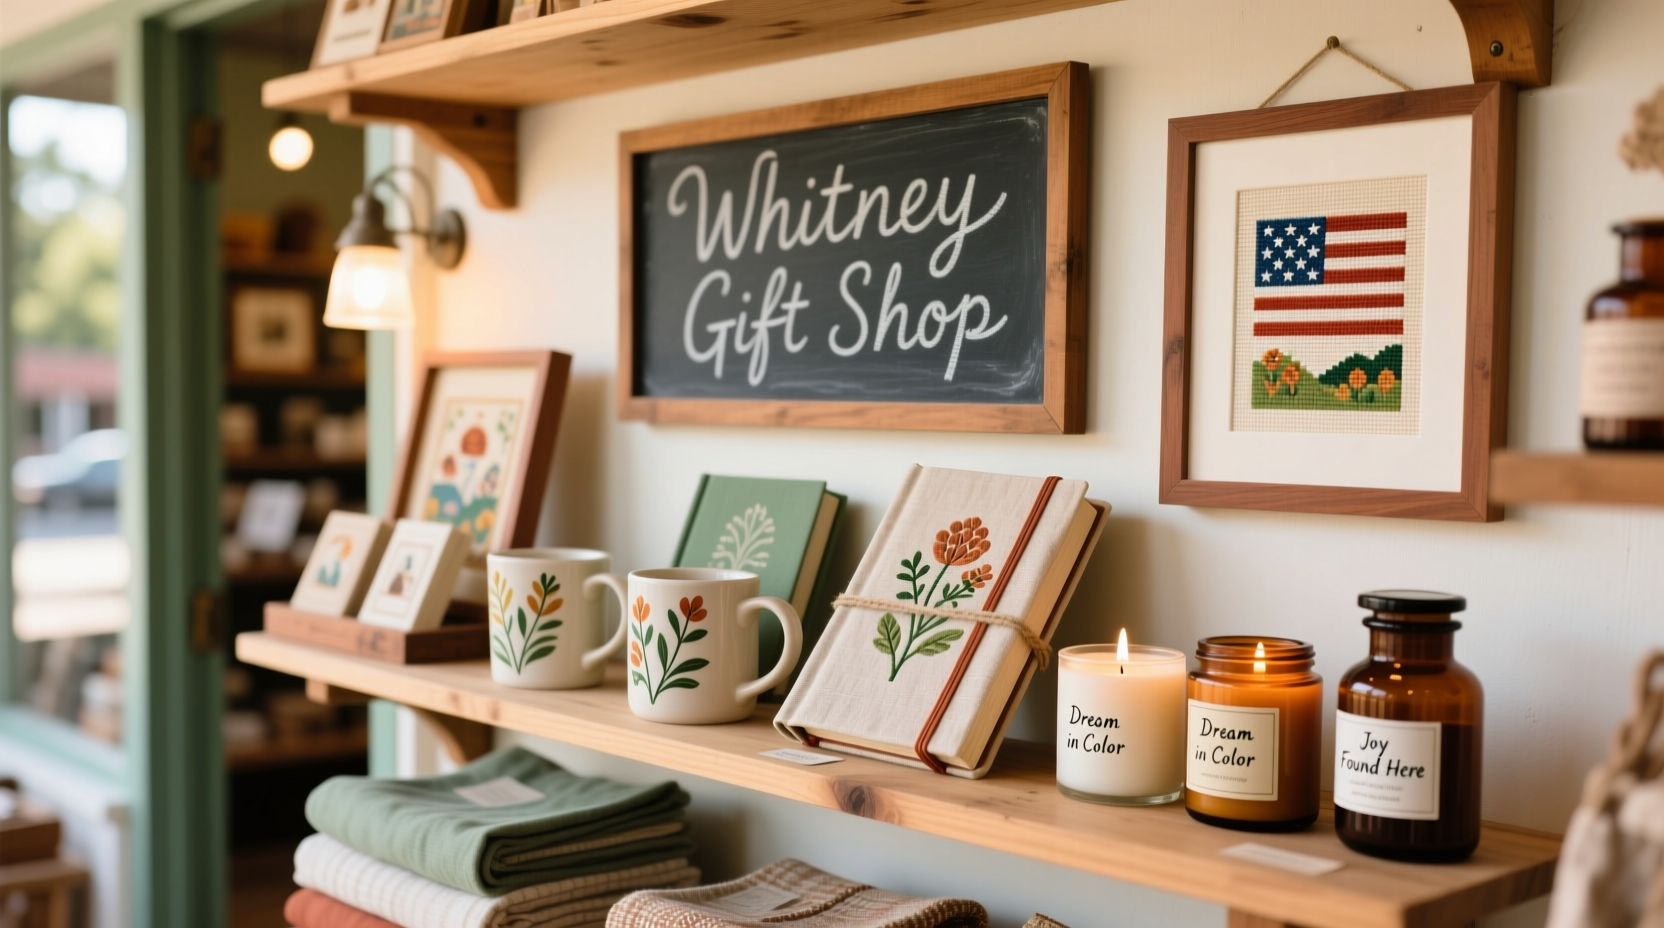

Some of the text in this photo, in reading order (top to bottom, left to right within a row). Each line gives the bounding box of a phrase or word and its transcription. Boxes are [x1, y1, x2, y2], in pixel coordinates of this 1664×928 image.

[667, 150, 1007, 278] Whitney
[683, 260, 1008, 387] Gift Shop
[1200, 717, 1254, 741] Dream
[1067, 733, 1126, 755] in Color
[1195, 745, 1256, 767] in Color
[1359, 731, 1389, 757] Joy
[1341, 750, 1425, 778] Found Here
